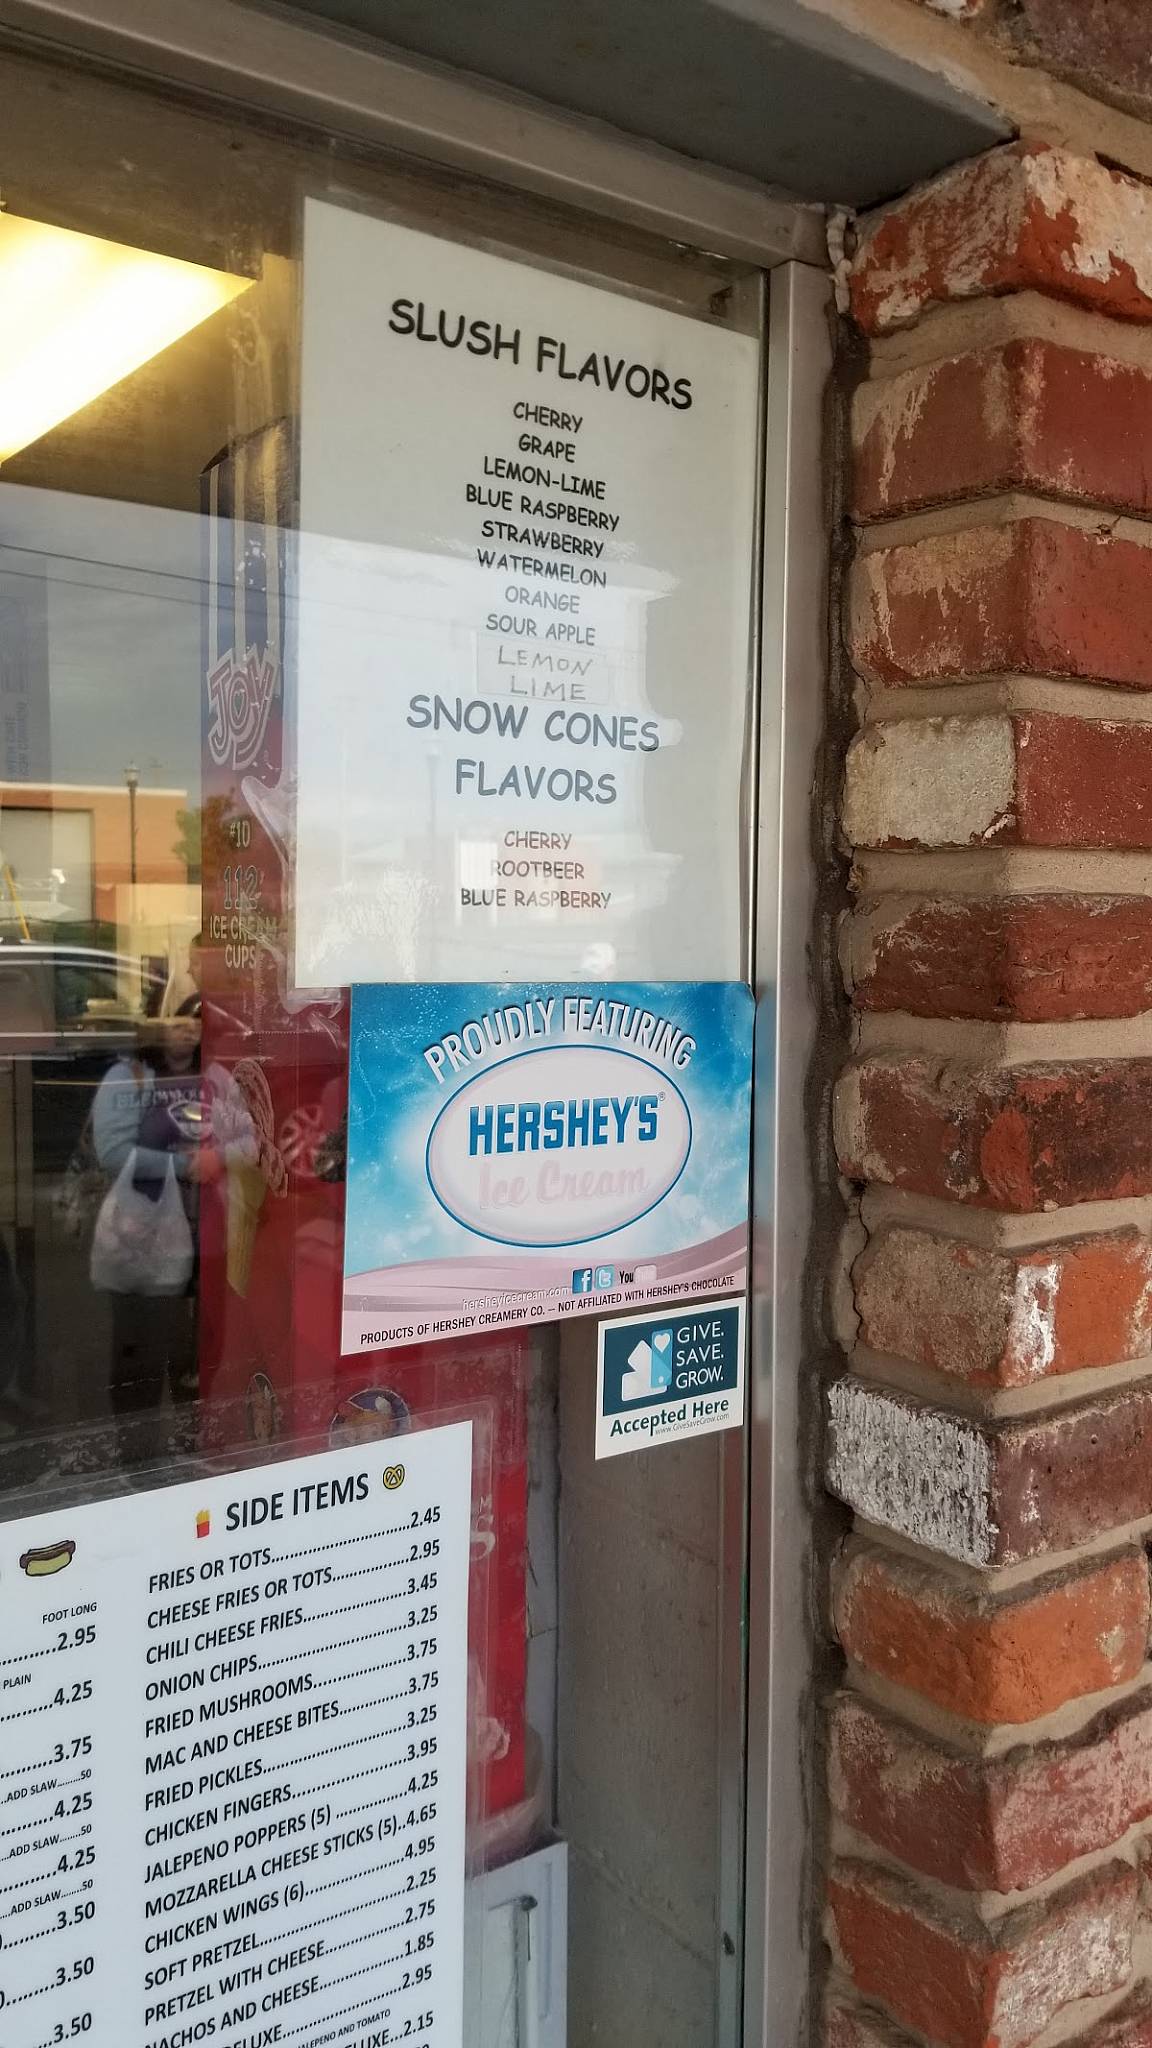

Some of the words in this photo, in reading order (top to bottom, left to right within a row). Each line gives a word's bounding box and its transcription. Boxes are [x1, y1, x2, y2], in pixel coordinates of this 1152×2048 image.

[388, 298, 520, 365] SLUSH
[536, 336, 693, 410] FLAVORS
[513, 402, 583, 433] CHERRY
[518, 434, 576, 463] GRAPE
[484, 456, 606, 500] LEMON-LIME
[465, 484, 512, 511] BLUE
[520, 496, 619, 532] RASPBERRY
[481, 520, 605, 558] STRAWBERRY
[477, 549, 607, 588] WATERMELON
[504, 585, 580, 614] ORANGE
[486, 613, 537, 637] SOUR
[545, 621, 596, 646] APPLE
[497, 645, 594, 677] LEMON
[510, 676, 586, 701] LIME
[406, 694, 529, 739] SNOW
[544, 710, 660, 752] CONES
[456, 758, 618, 805] FLAVORS
[504, 830, 572, 851] CHERRY
[490, 860, 584, 880] ROOTBEER
[223, 865, 258, 910] 112
[461, 888, 507, 906] BLUE
[514, 890, 612, 910] RASPBERRY
[210, 915, 227, 939] ICE
[225, 944, 256, 969] CUPS
[423, 998, 554, 1084] PROUDLY
[562, 995, 697, 1070] FEATURING
[469, 1094, 659, 1156] HERSHEY'S
[479, 1160, 528, 1210] Ice
[536, 1160, 649, 1205] Cream
[360, 1326, 414, 1345] PRODUCTS
[417, 1323, 430, 1336] OF
[433, 1316, 476, 1333] HERSHEY
[479, 1308, 528, 1325] CREAMERY
[530, 1305, 545, 1317] CO.
[558, 1301, 576, 1313] NOT
[577, 1293, 622, 1310] AFFILIATED
[625, 1289, 644, 1302] WITH
[647, 1282, 689, 1298] HERSHEY'S
[691, 1275, 735, 1291] CHOCOLATE
[677, 1321, 724, 1344] GIVE.
[676, 1343, 724, 1367] SAVE.
[675, 1365, 724, 1389] GROW.
[610, 1404, 687, 1437] Accepted
[692, 1399, 729, 1418] Here
[226, 1492, 283, 1531] SIDE
[293, 1473, 369, 1515] ITEMS
[149, 1566, 195, 1593] FRIES
[200, 1559, 224, 1580] OR
[229, 1548, 271, 1573] TOTS
[411, 1506, 441, 1528] 2.45
[147, 1598, 210, 1629] CHEESE
[216, 1585, 259, 1612] FRIES
[264, 1579, 287, 1598] OR
[293, 1567, 332, 1591] TOTS
[410, 1539, 440, 1561] 2.95
[42, 1609, 69, 1624] FOOT
[71, 1602, 97, 1617] LONG
[146, 1638, 189, 1664] CHILI
[194, 1620, 255, 1651] CHEESE
[260, 1608, 303, 1634] FRIES
[407, 1572, 438, 1595] 3.45
[57, 1624, 96, 1651] 2.95
[145, 1669, 204, 1701] ONION
[210, 1654, 257, 1682] CHIPS
[408, 1605, 438, 1627] 3.25
[3, 1673, 32, 1690] PLAIN
[54, 1680, 93, 1706] 4.25
[145, 1709, 194, 1738] FRIED
[200, 1673, 313, 1722] MUSHROOMS
[407, 1638, 437, 1661] 3.75
[145, 1746, 186, 1775] MAC
[191, 1734, 228, 1761] AND
[233, 1714, 292, 1747] CHEESE
[297, 1700, 339, 1728] BITES
[408, 1671, 439, 1694] 3.75
[54, 1735, 92, 1763] 3.75
[145, 1781, 194, 1811] FRIED
[199, 1759, 263, 1794] PICKLES
[407, 1704, 437, 1728] 3.25
[30, 1779, 58, 1796] SLAW
[145, 1807, 218, 1846] CHICKEN
[224, 1784, 291, 1821] FINGERS
[407, 1737, 438, 1761] 3.95
[54, 1791, 92, 1818] 4.25
[33, 1834, 60, 1851] SLAW
[145, 1840, 229, 1883] JALEPENO
[234, 1814, 306, 1853] POPPERS
[311, 1804, 331, 1830] (5)
[408, 1770, 438, 1793] 4.25
[57, 1845, 96, 1873] 4.25
[145, 1865, 257, 1918] MOZZARELLA
[261, 1843, 319, 1877] CHEESE
[324, 1824, 374, 1856] STICKS
[407, 1803, 437, 1826] 4.65
[34, 1889, 62, 1907] SLAW
[145, 1912, 218, 1954] CHICKEN
[223, 1891, 279, 1925] WINGS
[405, 1836, 435, 1860] 4.95
[57, 1901, 95, 1929] 3.50
[145, 1958, 187, 1990] SOFT
[192, 1932, 259, 1972] PRETZEL
[406, 1867, 437, 1892] 2.25
[56, 1956, 94, 1986] 3.50
[145, 1984, 214, 2026] PRETZEL
[219, 1964, 262, 1995] WITH
[268, 1940, 325, 1976] CHEESE
[405, 1899, 435, 1924] 2.75
[402, 1964, 432, 1990] 2.95
[221, 2001, 256, 2030] AND
[262, 1976, 319, 2012] CHEESE
[405, 1931, 434, 1956] 1.85
[54, 2012, 92, 2044] 3.50
[338, 2023, 355, 2037] AND
[357, 2008, 391, 2030] TOMATO
[404, 2010, 434, 2037] 2.15
